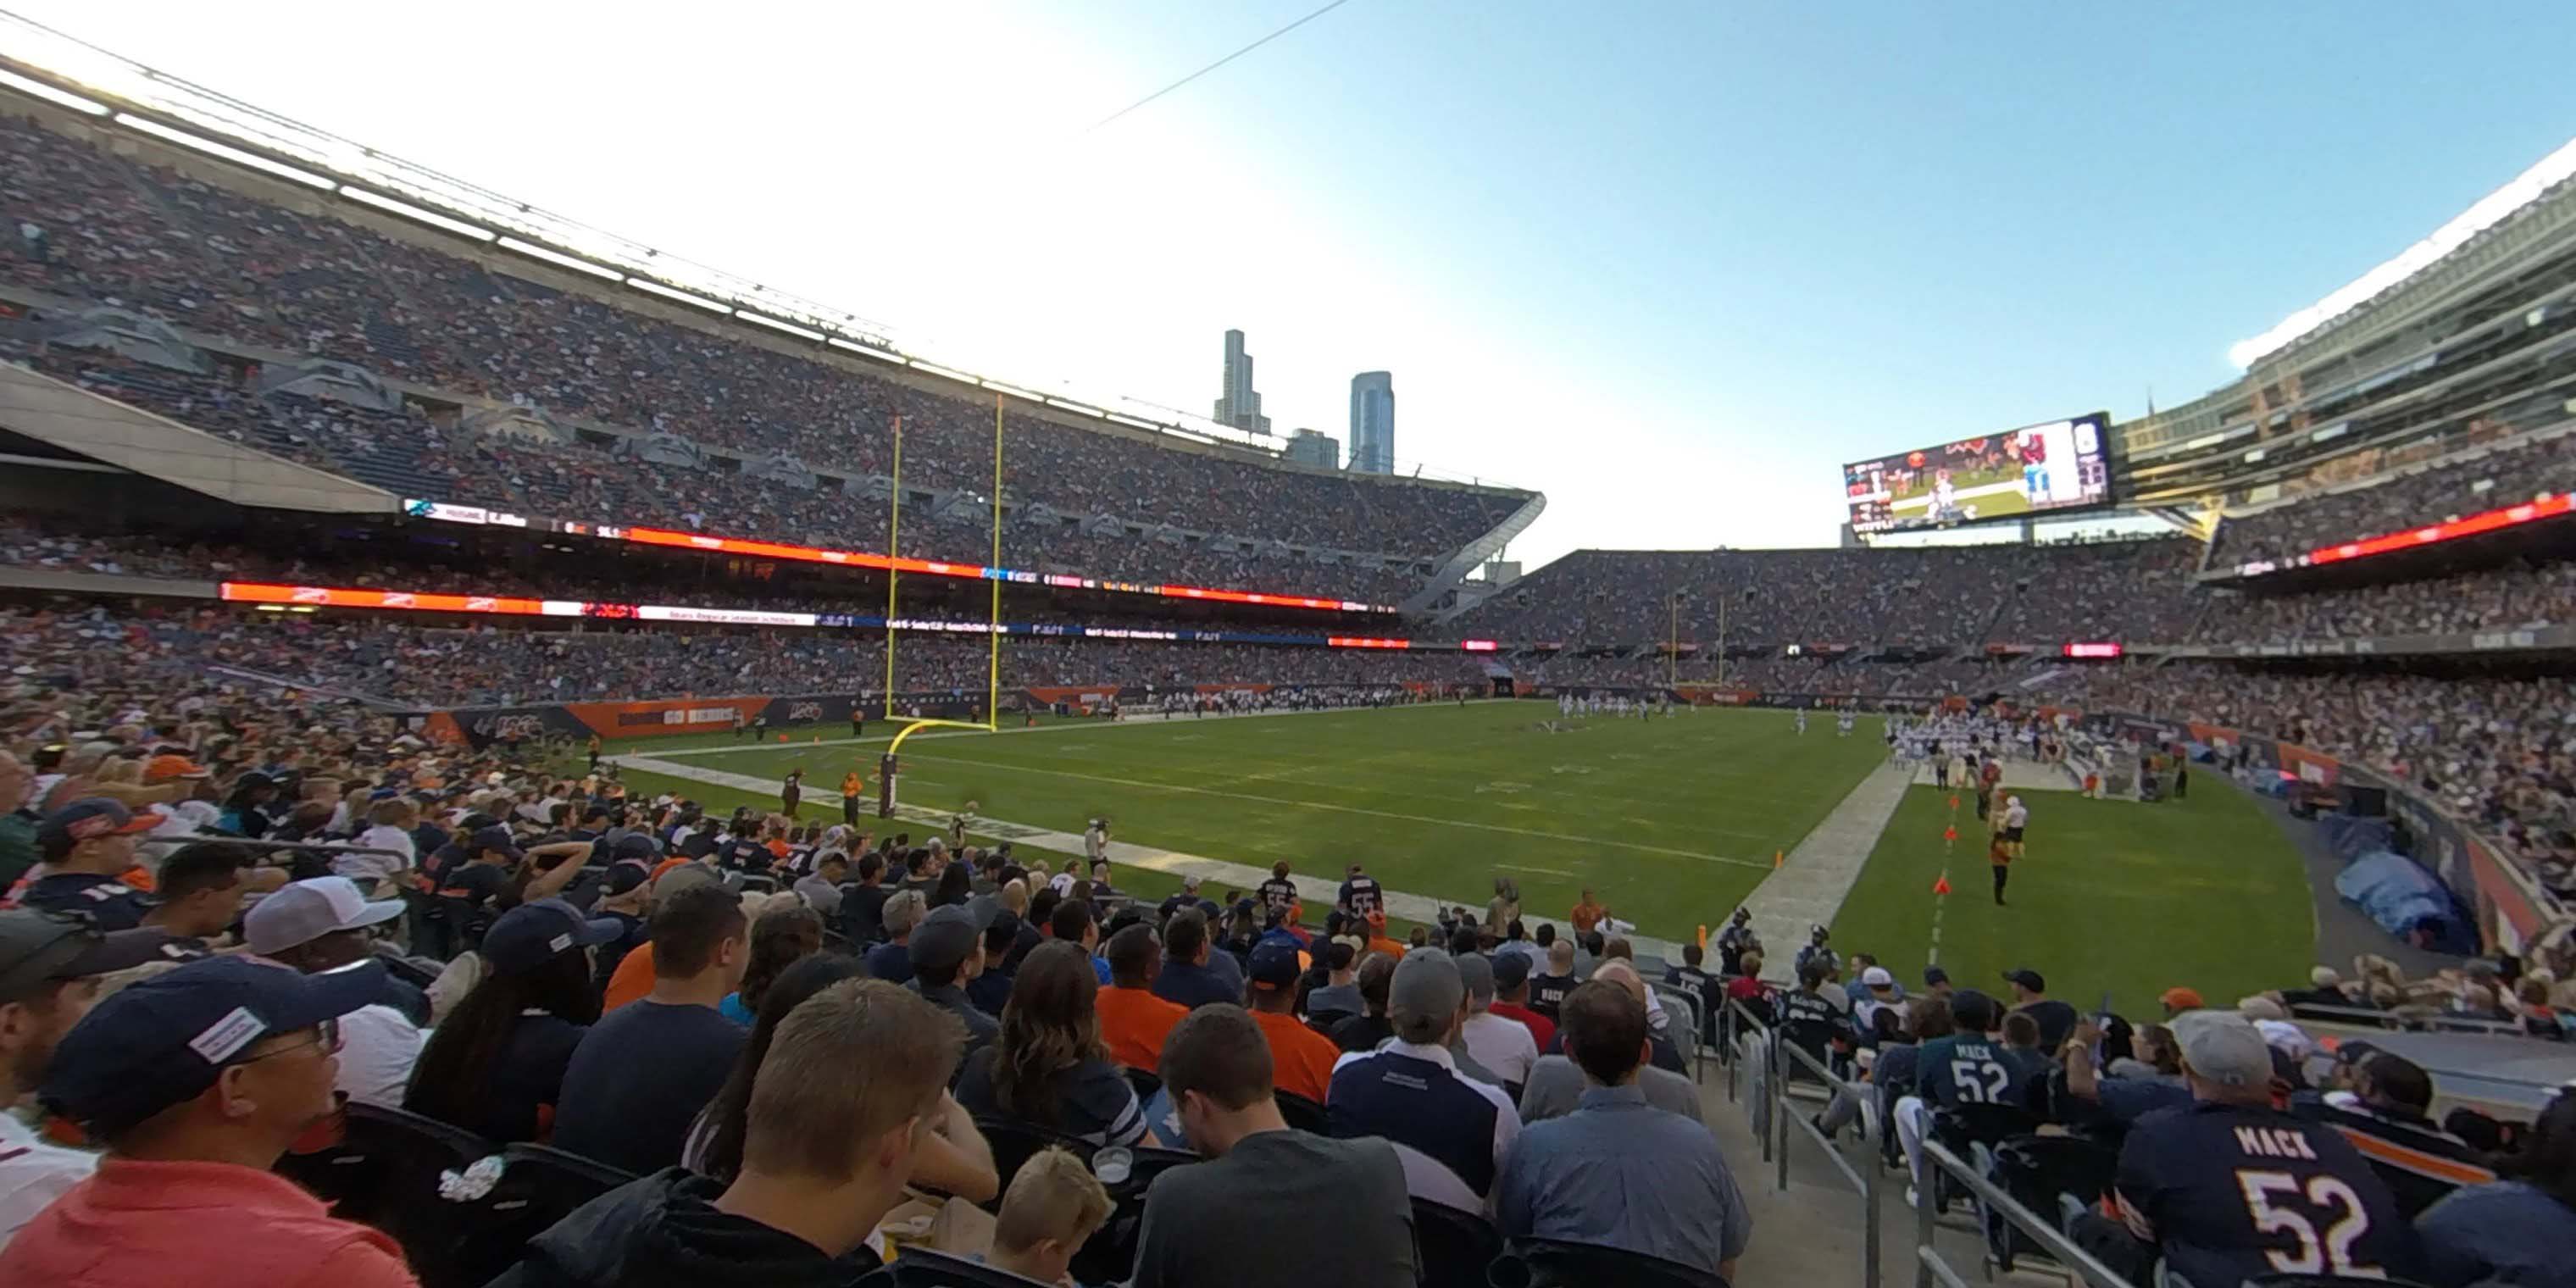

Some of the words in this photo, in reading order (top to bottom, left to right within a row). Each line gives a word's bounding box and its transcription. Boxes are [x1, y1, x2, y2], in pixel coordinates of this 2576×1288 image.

[1956, 1043, 1992, 1060] MACK
[1951, 1060, 2015, 1106] 52
[2233, 1125, 2318, 1160] MACK
[2234, 1168, 2388, 1280] 52
